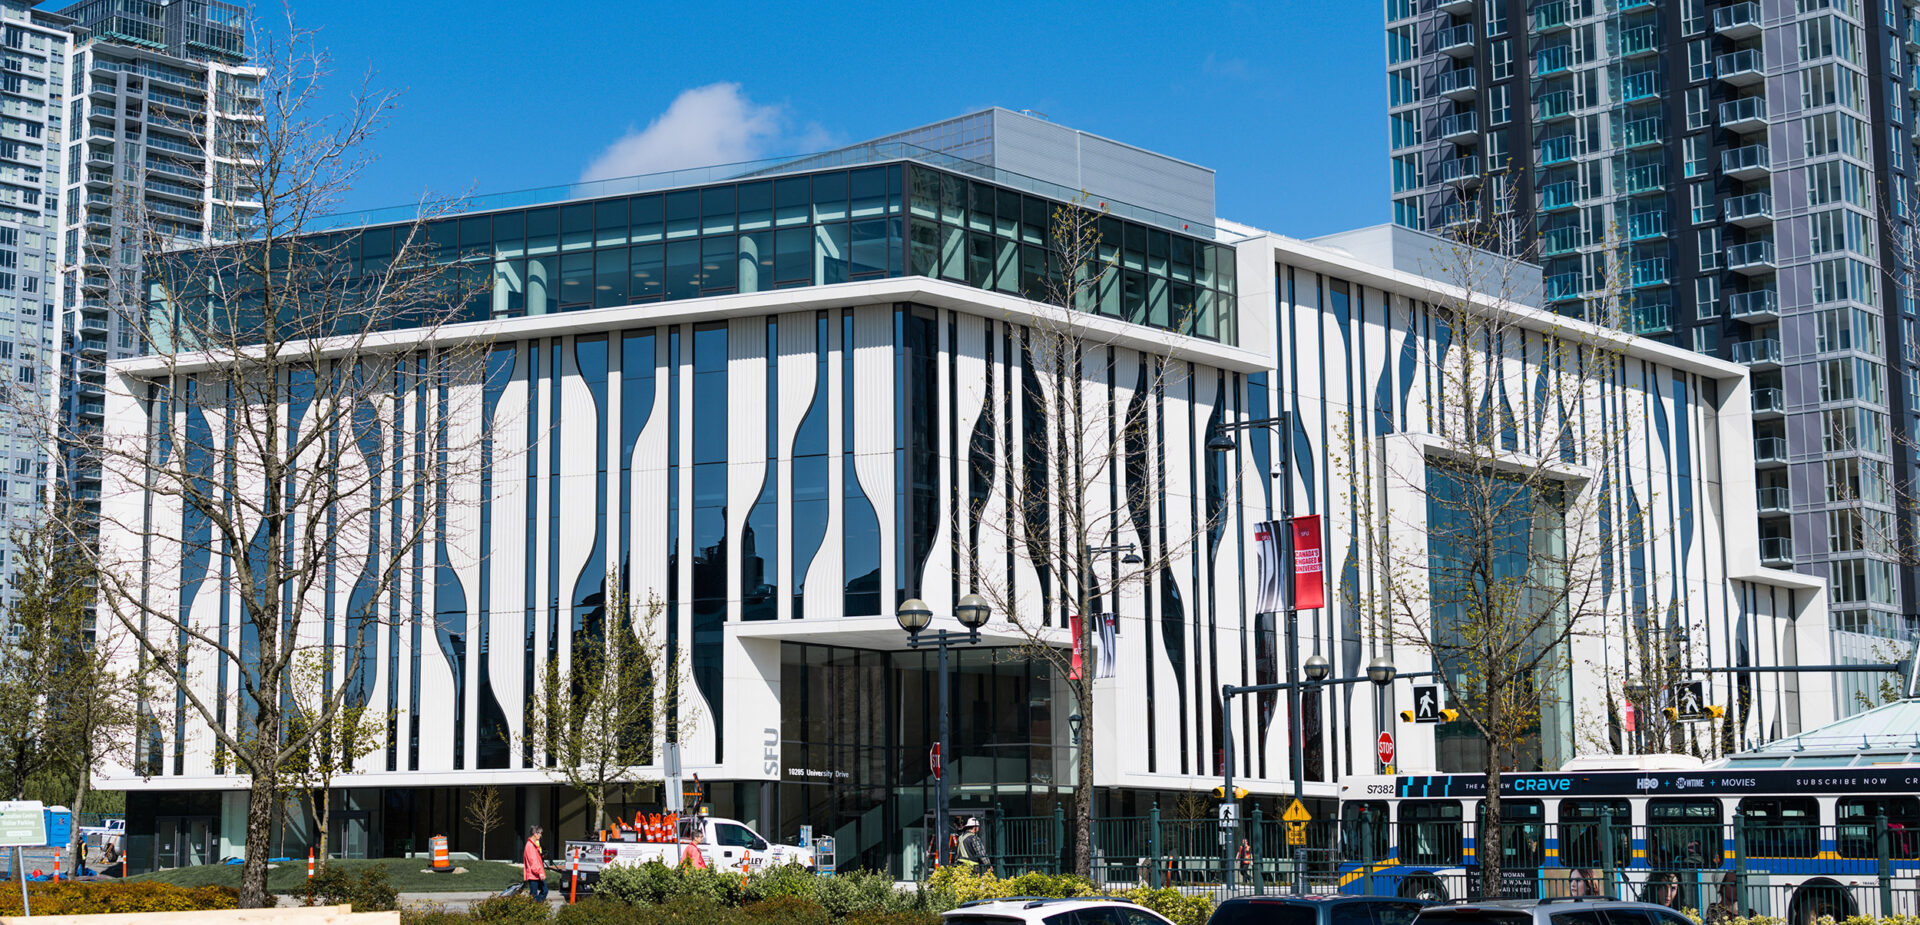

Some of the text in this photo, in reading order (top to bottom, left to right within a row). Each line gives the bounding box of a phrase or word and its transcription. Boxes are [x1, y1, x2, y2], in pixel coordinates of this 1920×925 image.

[764, 728, 779, 776] SFU
[1379, 742, 1393, 754] STOP
[806, 769, 833, 779] University
[835, 770, 849, 778] Drive
[1637, 778, 1659, 789] HBO
[1676, 777, 1704, 789] SHOWTIME
[1721, 779, 1756, 787] MOVIES
[1796, 778, 1857, 786] SUBSCRIBE
[1367, 785, 1394, 794] S7382
